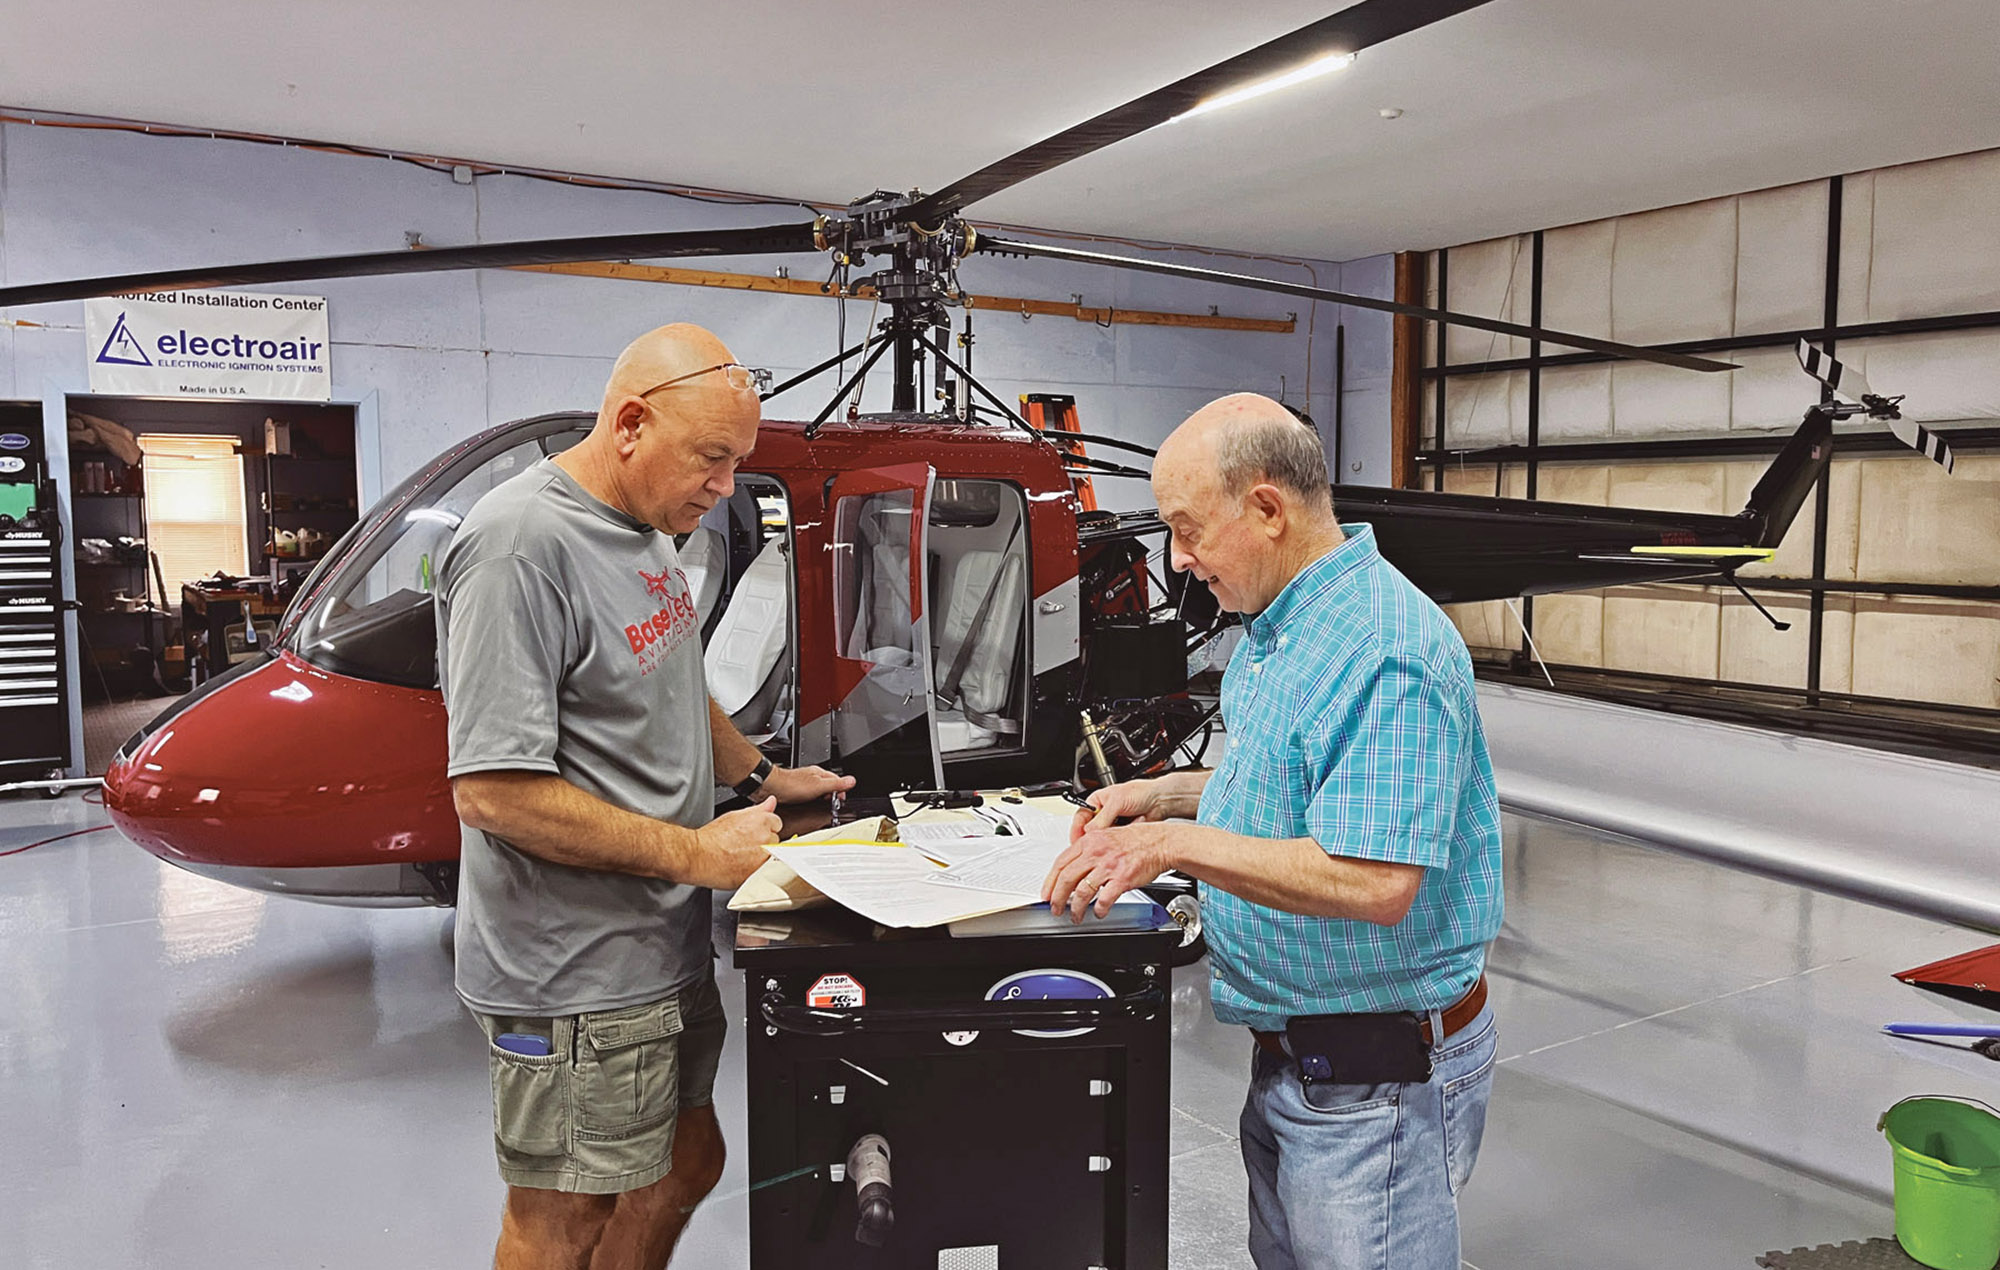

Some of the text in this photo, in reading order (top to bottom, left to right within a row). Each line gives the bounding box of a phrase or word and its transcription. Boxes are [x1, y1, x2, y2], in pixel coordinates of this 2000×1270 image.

[182, 292, 268, 309] Installation
[272, 298, 324, 311] Center
[157, 330, 322, 360] electroair
[158, 359, 324, 374] ELECTRONIC IGNITION SYSTEMS
[179, 385, 206, 394] Made
[208, 386, 218, 395] in
[638, 619, 691, 667] AVIATION
[824, 977, 848, 985] STOP!
